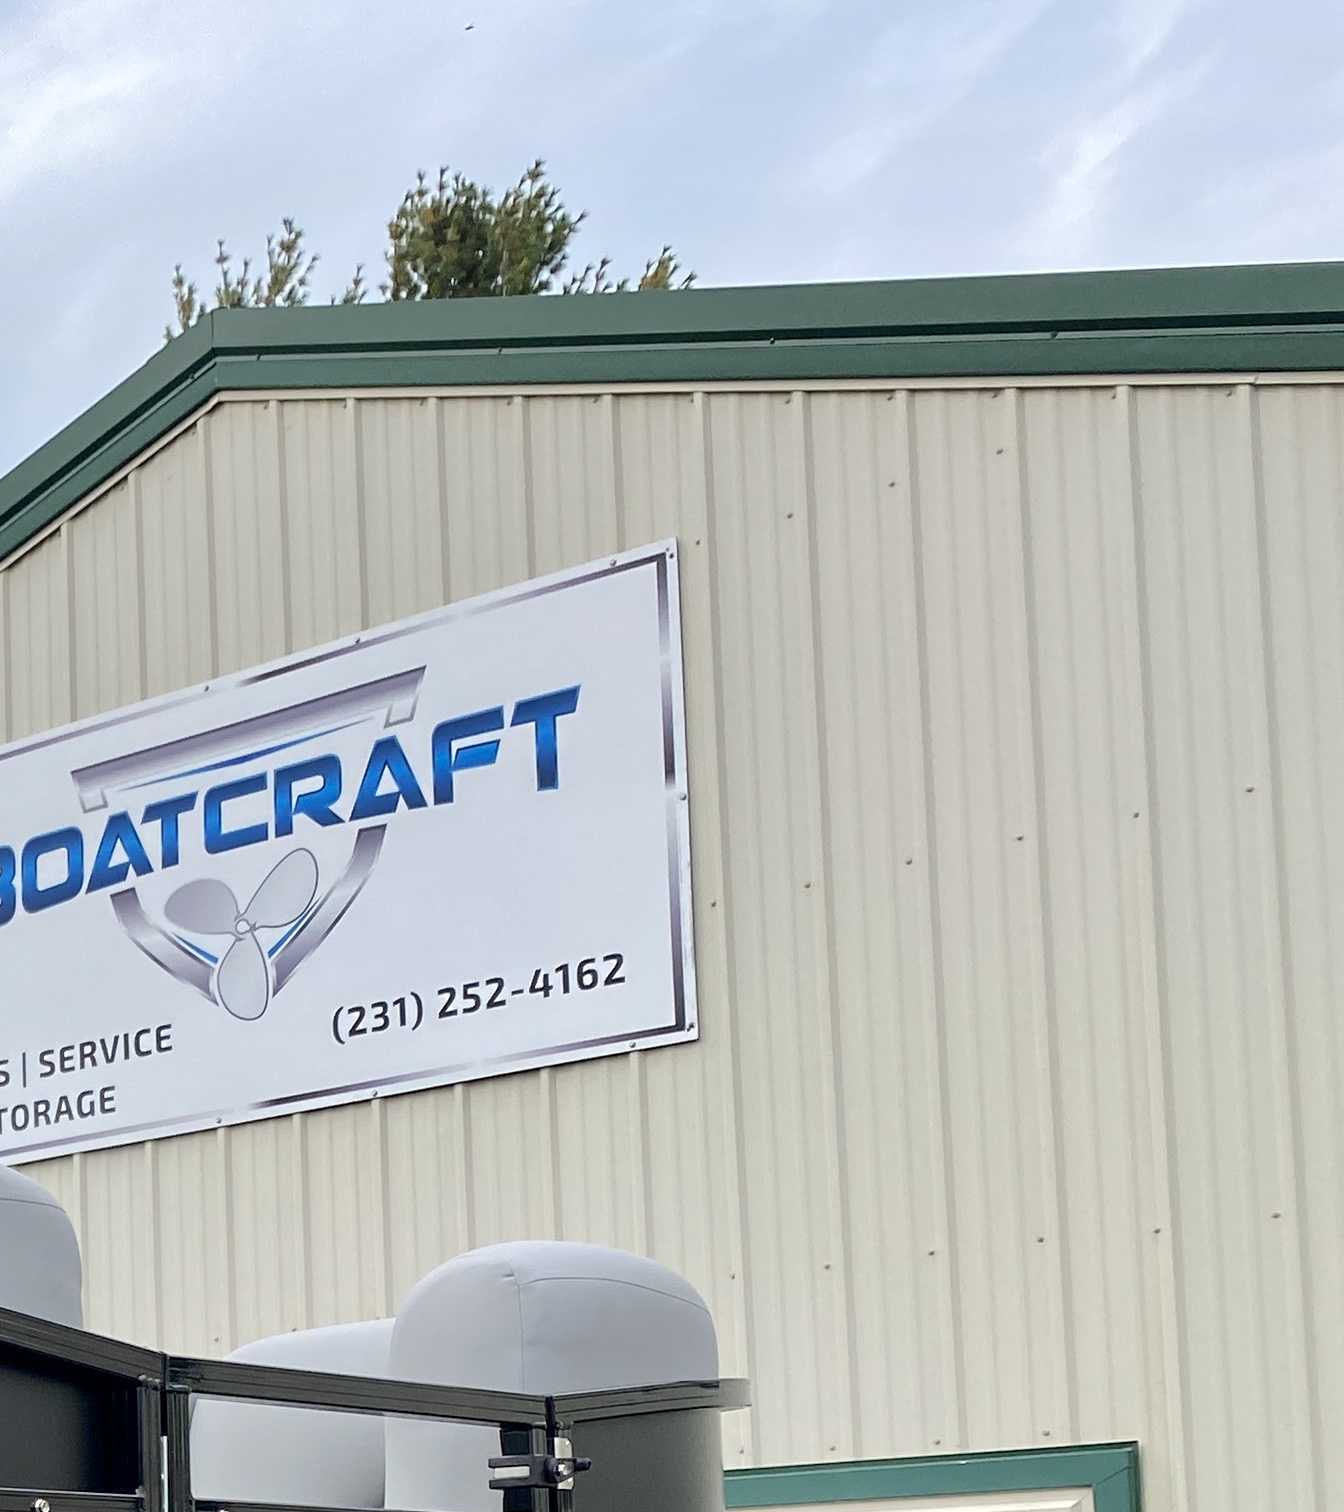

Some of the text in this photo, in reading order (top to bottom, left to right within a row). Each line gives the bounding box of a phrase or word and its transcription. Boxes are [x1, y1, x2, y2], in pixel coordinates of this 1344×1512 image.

[332, 953, 626, 1044] (231) 252-4162
[39, 1023, 173, 1078] SERVICE
